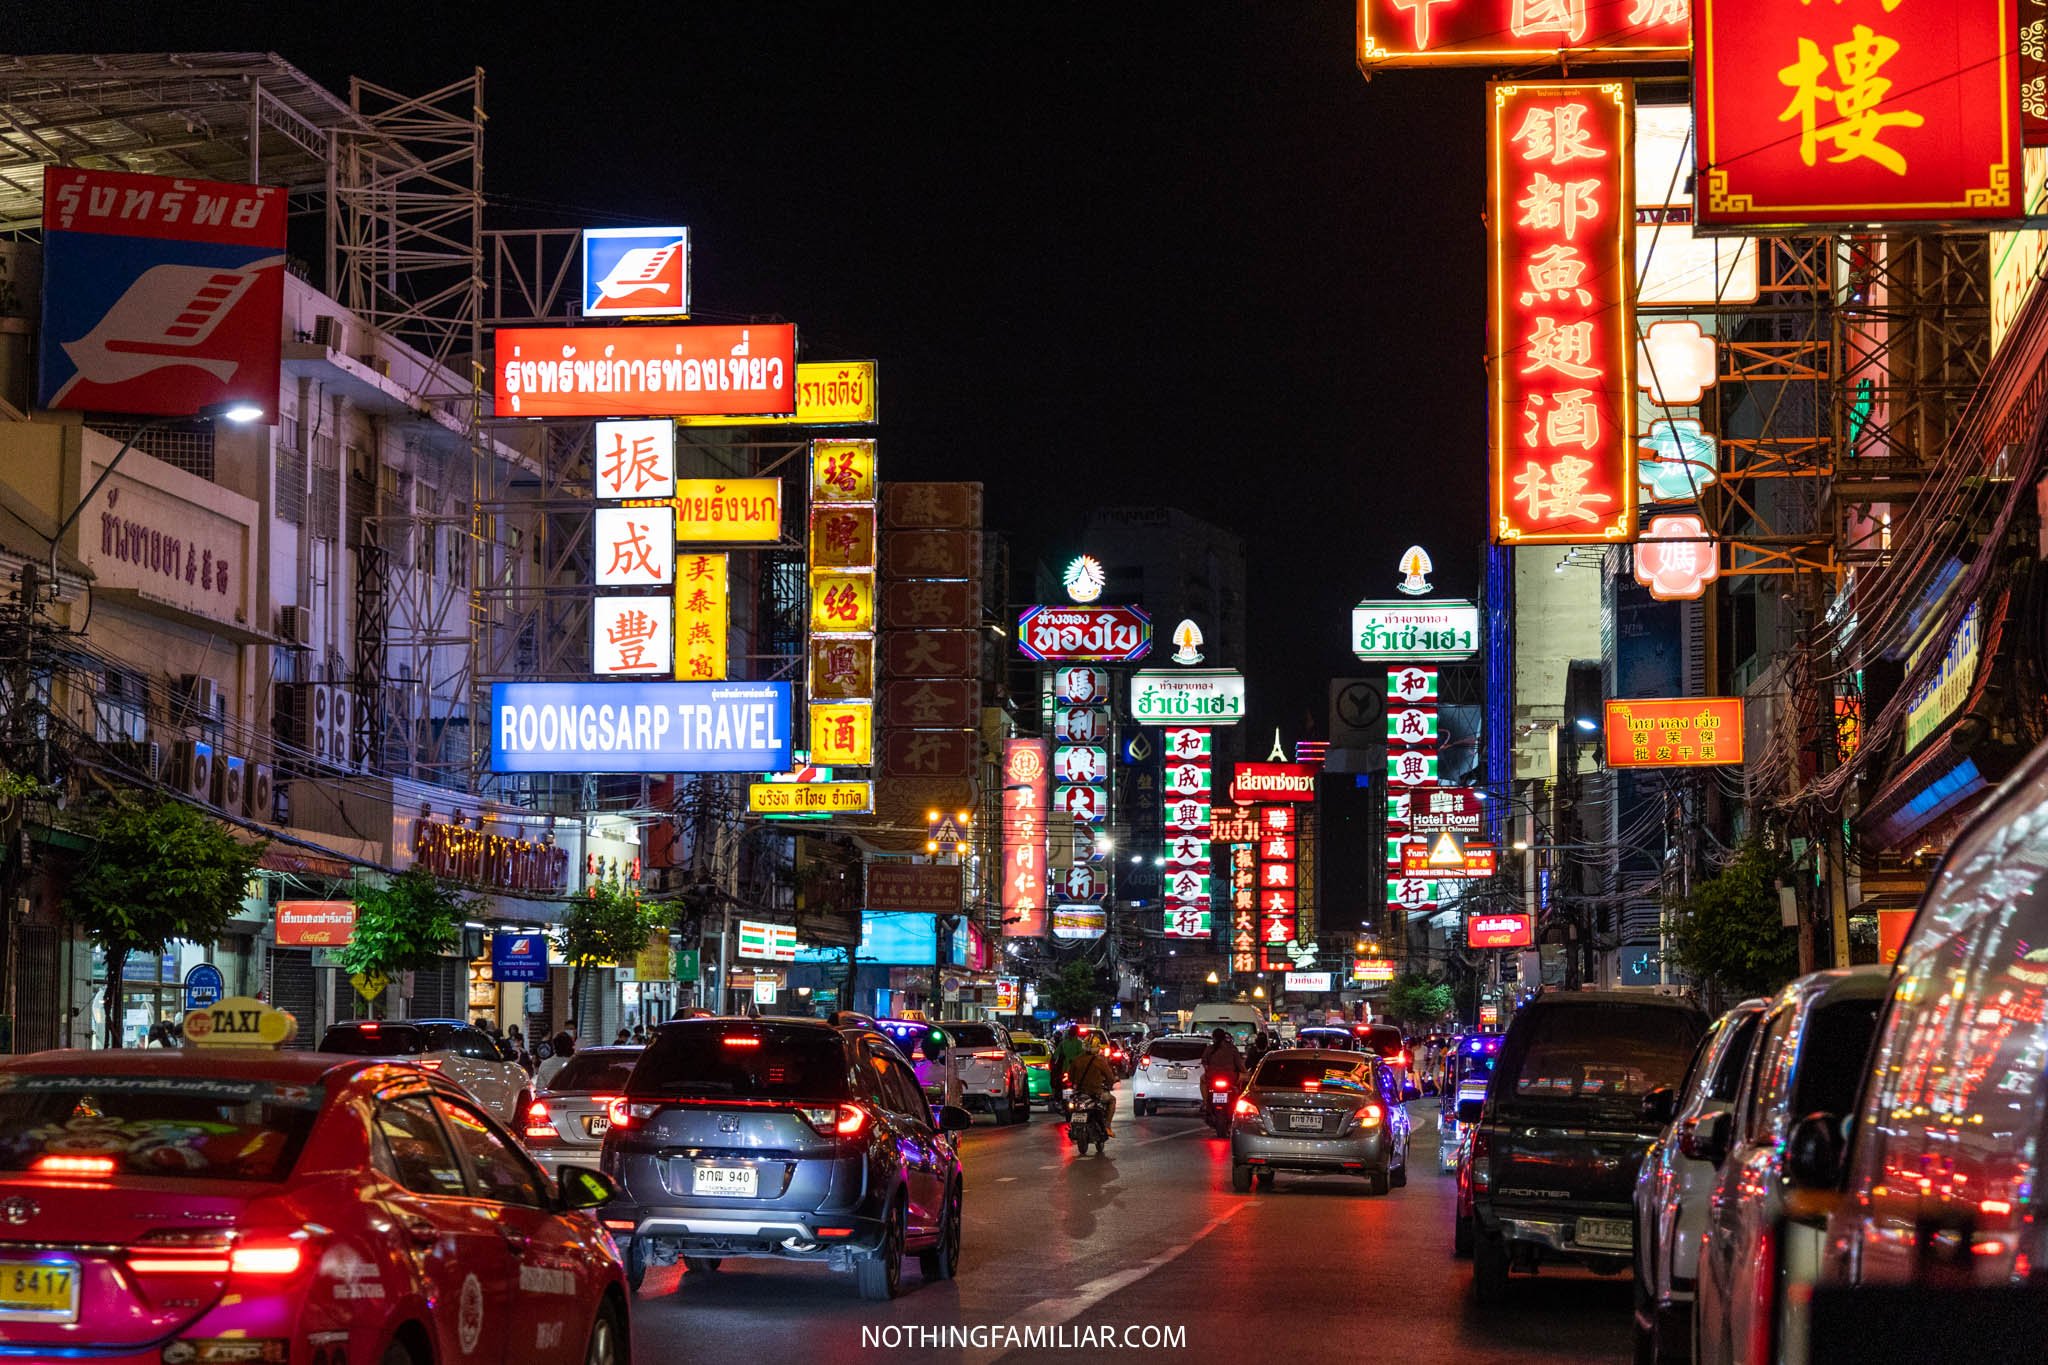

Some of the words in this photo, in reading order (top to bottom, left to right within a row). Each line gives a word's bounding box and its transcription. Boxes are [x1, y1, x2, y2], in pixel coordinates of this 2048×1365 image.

[1778, 0, 1925, 176] 樓
[56, 175, 276, 229] รุ่งทรัพย์
[1511, 104, 1611, 523] 銀都魚翅酒樓
[505, 329, 783, 412] รุ่งทรัพย์การท่องเที่ยว
[676, 485, 775, 522] ทยรังนก
[1033, 614, 1137, 652] ทองใบ
[1038, 609, 1090, 626] ห้างทอง
[501, 704, 670, 751] ROONGSARP
[682, 704, 782, 751] TRAVEL
[1399, 672, 1426, 904] 和成興行
[1177, 733, 1201, 934] 和成興大金行
[1413, 814, 1443, 825] Hotel
[1014, 787, 1036, 922] 北京同仁堂
[1267, 809, 1289, 969] 聯成興大金
[211, 1010, 263, 1034] TAXI
[729, 1170, 750, 1183] 940
[1498, 1187, 1570, 1199] FRONTIER
